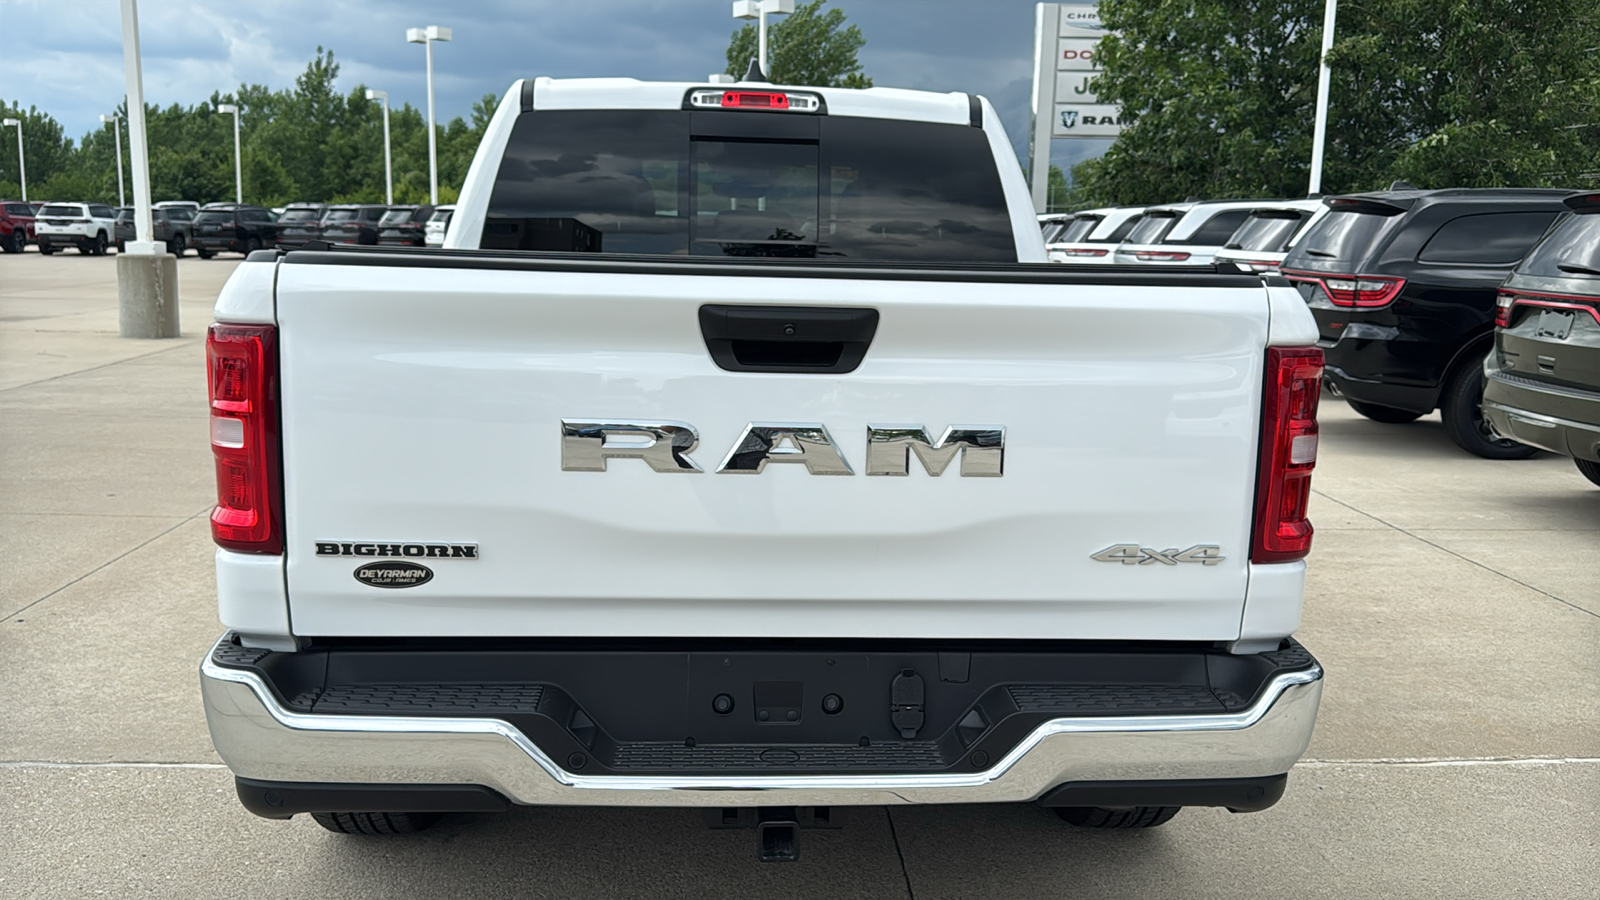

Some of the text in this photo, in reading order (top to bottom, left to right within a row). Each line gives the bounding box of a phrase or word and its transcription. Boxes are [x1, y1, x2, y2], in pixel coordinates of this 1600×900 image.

[1064, 50, 1092, 60] DO
[561, 418, 1006, 477] RAM
[315, 541, 479, 559] BIGHORN
[360, 569, 426, 578] DEYARMAN
